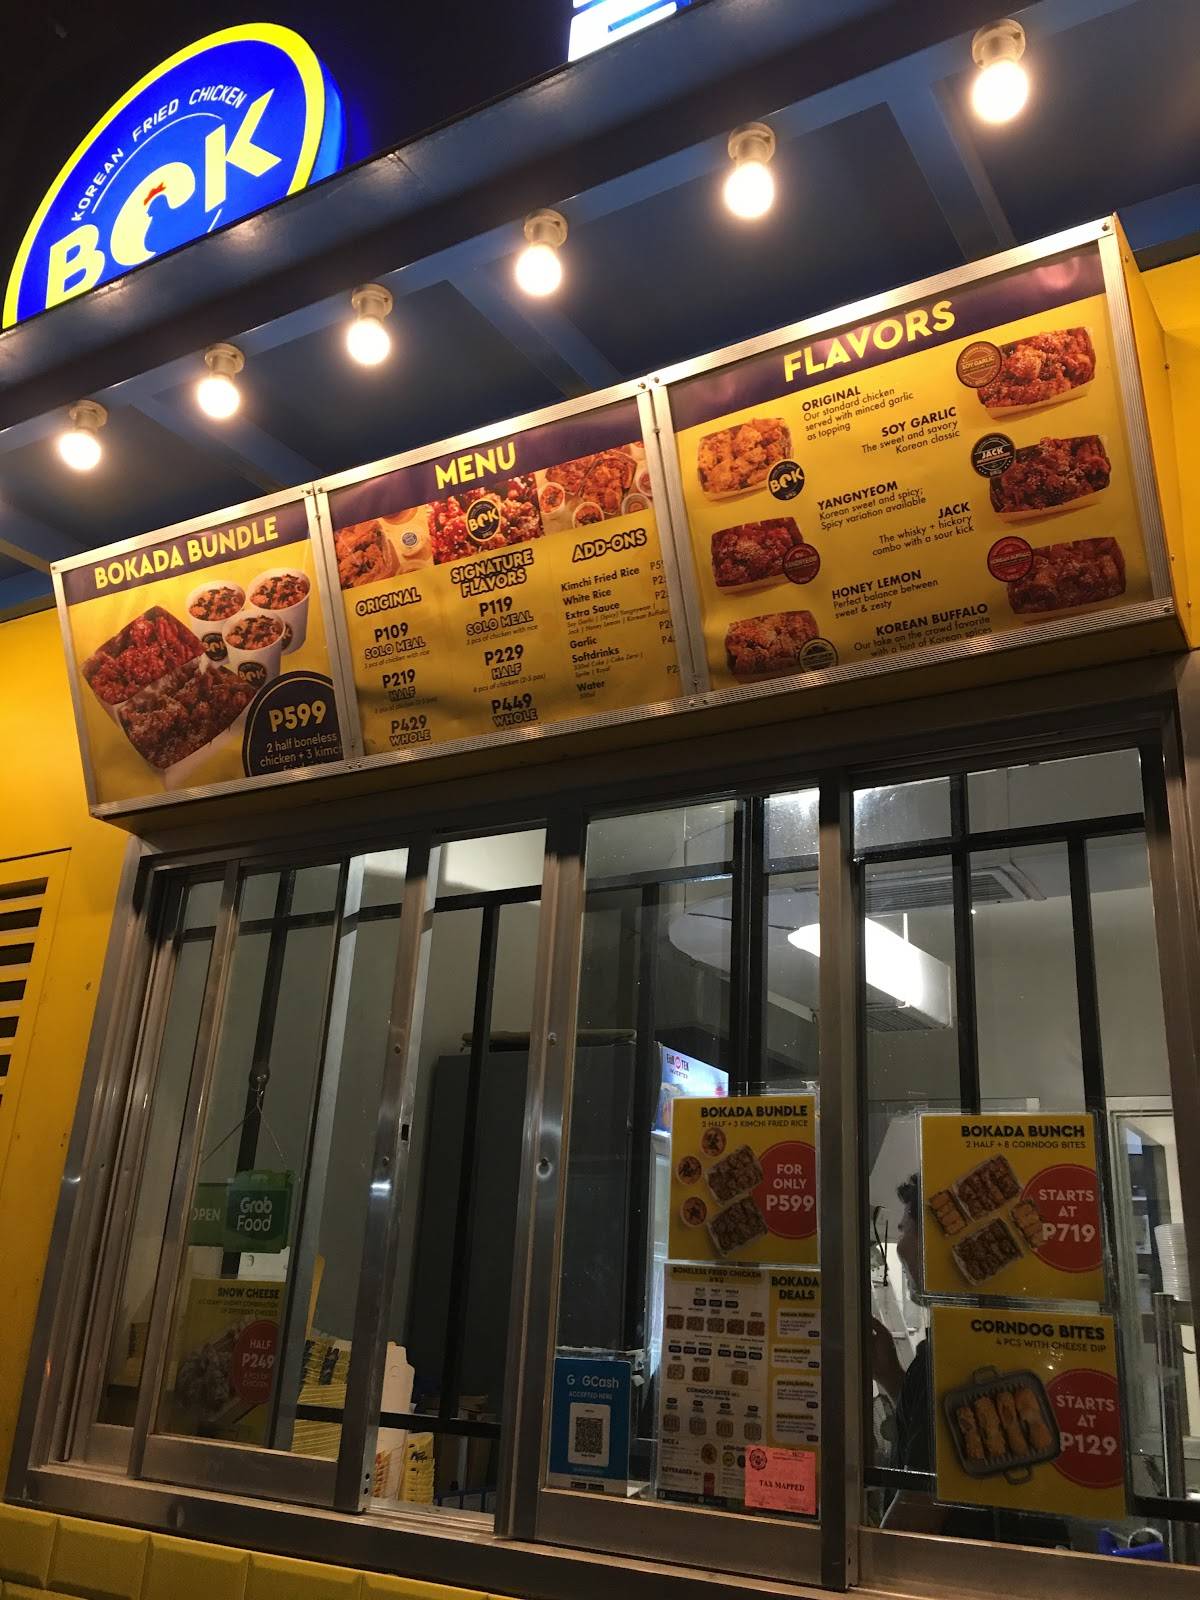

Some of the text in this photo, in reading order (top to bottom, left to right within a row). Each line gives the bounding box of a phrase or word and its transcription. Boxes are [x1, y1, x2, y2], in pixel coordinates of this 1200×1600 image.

[71, 84, 247, 221] KOREAN FRIED CHICKEN
[783, 300, 956, 383] FLAVORS
[802, 385, 861, 412] ORIGINAL
[804, 388, 895, 422] Our standard chicken
[805, 392, 914, 432] served with minced garlic
[881, 406, 957, 437] SOY GARLIC
[818, 423, 851, 438] topping
[862, 420, 958, 454] The sweet and savory
[895, 430, 960, 454] Korean classic
[982, 447, 1004, 459] JACK
[435, 442, 516, 490] MENU
[817, 481, 898, 511] YANGNYEOM
[819, 507, 849, 521] Korean
[852, 500, 876, 511] sweet
[879, 493, 895, 505] and
[821, 497, 926, 531] Spicy variation available
[938, 502, 970, 519] JACK
[879, 534, 895, 544] The
[897, 525, 927, 538] whisky
[938, 515, 972, 530] hickory
[571, 528, 647, 562] ADD-ONS
[872, 543, 901, 556] combo
[904, 537, 923, 548] with
[934, 531, 953, 541] sour
[955, 525, 974, 537] kick
[94, 516, 278, 589] BOKADA BUNDLE
[450, 548, 534, 584] SIGNATURE
[461, 567, 527, 598] FLAVORS
[561, 566, 640, 592] Kimchi Fried Rice
[832, 570, 922, 600] HONEY LEMON
[356, 587, 421, 616] ORIGINAL
[563, 588, 612, 606] White Rice
[833, 580, 938, 609] Perfect balance between
[479, 596, 512, 617] P119
[565, 602, 620, 620] Extra Sauce
[835, 600, 892, 619] sweet & zesty
[466, 610, 534, 636] SOLO MEAL
[876, 603, 988, 636] KOREAN BUFFALO
[374, 622, 409, 642] P109
[570, 636, 598, 649] Garlic
[854, 616, 990, 651] Our take on the crowd favorite
[870, 648, 889, 658] with
[900, 642, 916, 652] hint
[918, 639, 928, 648] of
[930, 632, 962, 645] Korean
[965, 627, 993, 638] spices
[365, 636, 426, 660] SOLO MEAL
[484, 644, 523, 666] P229
[572, 636, 675, 663] Softdrinks P4
[382, 669, 415, 688] P219
[491, 662, 522, 680] HALF
[576, 665, 679, 692] Water P2
[388, 686, 416, 702] HALF
[491, 693, 532, 714] P449
[268, 700, 326, 732] P599
[391, 715, 427, 734] P429
[492, 708, 538, 727] WHOLE
[266, 732, 337, 753] 2 half boneless
[389, 729, 431, 747] WHOLE
[260, 752, 296, 767] chicken
[306, 749, 313, 760] 3
[315, 745, 341, 759] kimc
[701, 1105, 808, 1118] BOKADA BUNDLE
[740, 1120, 766, 1128] KIMCHI
[768, 1119, 788, 1127] FRIED
[791, 1119, 808, 1127] RICE
[961, 1125, 1085, 1138] BOKADA BUNCH
[1012, 1141, 1059, 1149] CORNDOG
[1061, 1141, 1086, 1149] BITES
[777, 1164, 802, 1175] FOR
[773, 1177, 807, 1189] ONLY
[240, 1196, 272, 1215] Grab
[766, 1194, 815, 1211] P599
[1039, 1189, 1094, 1201] STARTS
[1058, 1206, 1077, 1217] AT
[236, 1215, 272, 1232] Food
[1042, 1223, 1096, 1243] P719
[771, 1276, 819, 1287] BOKADA
[218, 1287, 279, 1299] SNOW CHEESE
[779, 1290, 815, 1300] DEALS
[971, 1319, 1105, 1340] CORNDOG BITES
[250, 1339, 272, 1350] HALF
[1004, 1339, 1022, 1347] PCS
[1024, 1340, 1049, 1349] WITH
[1051, 1342, 1087, 1352] CHEESE
[1090, 1344, 1106, 1352] DIP
[242, 1353, 274, 1369] P249
[582, 1375, 619, 1389] GCash
[1056, 1395, 1115, 1411] STARTS
[1077, 1415, 1096, 1428] AT
[1060, 1432, 1117, 1456] P129
[759, 1480, 805, 1492] TAX MAPPED
